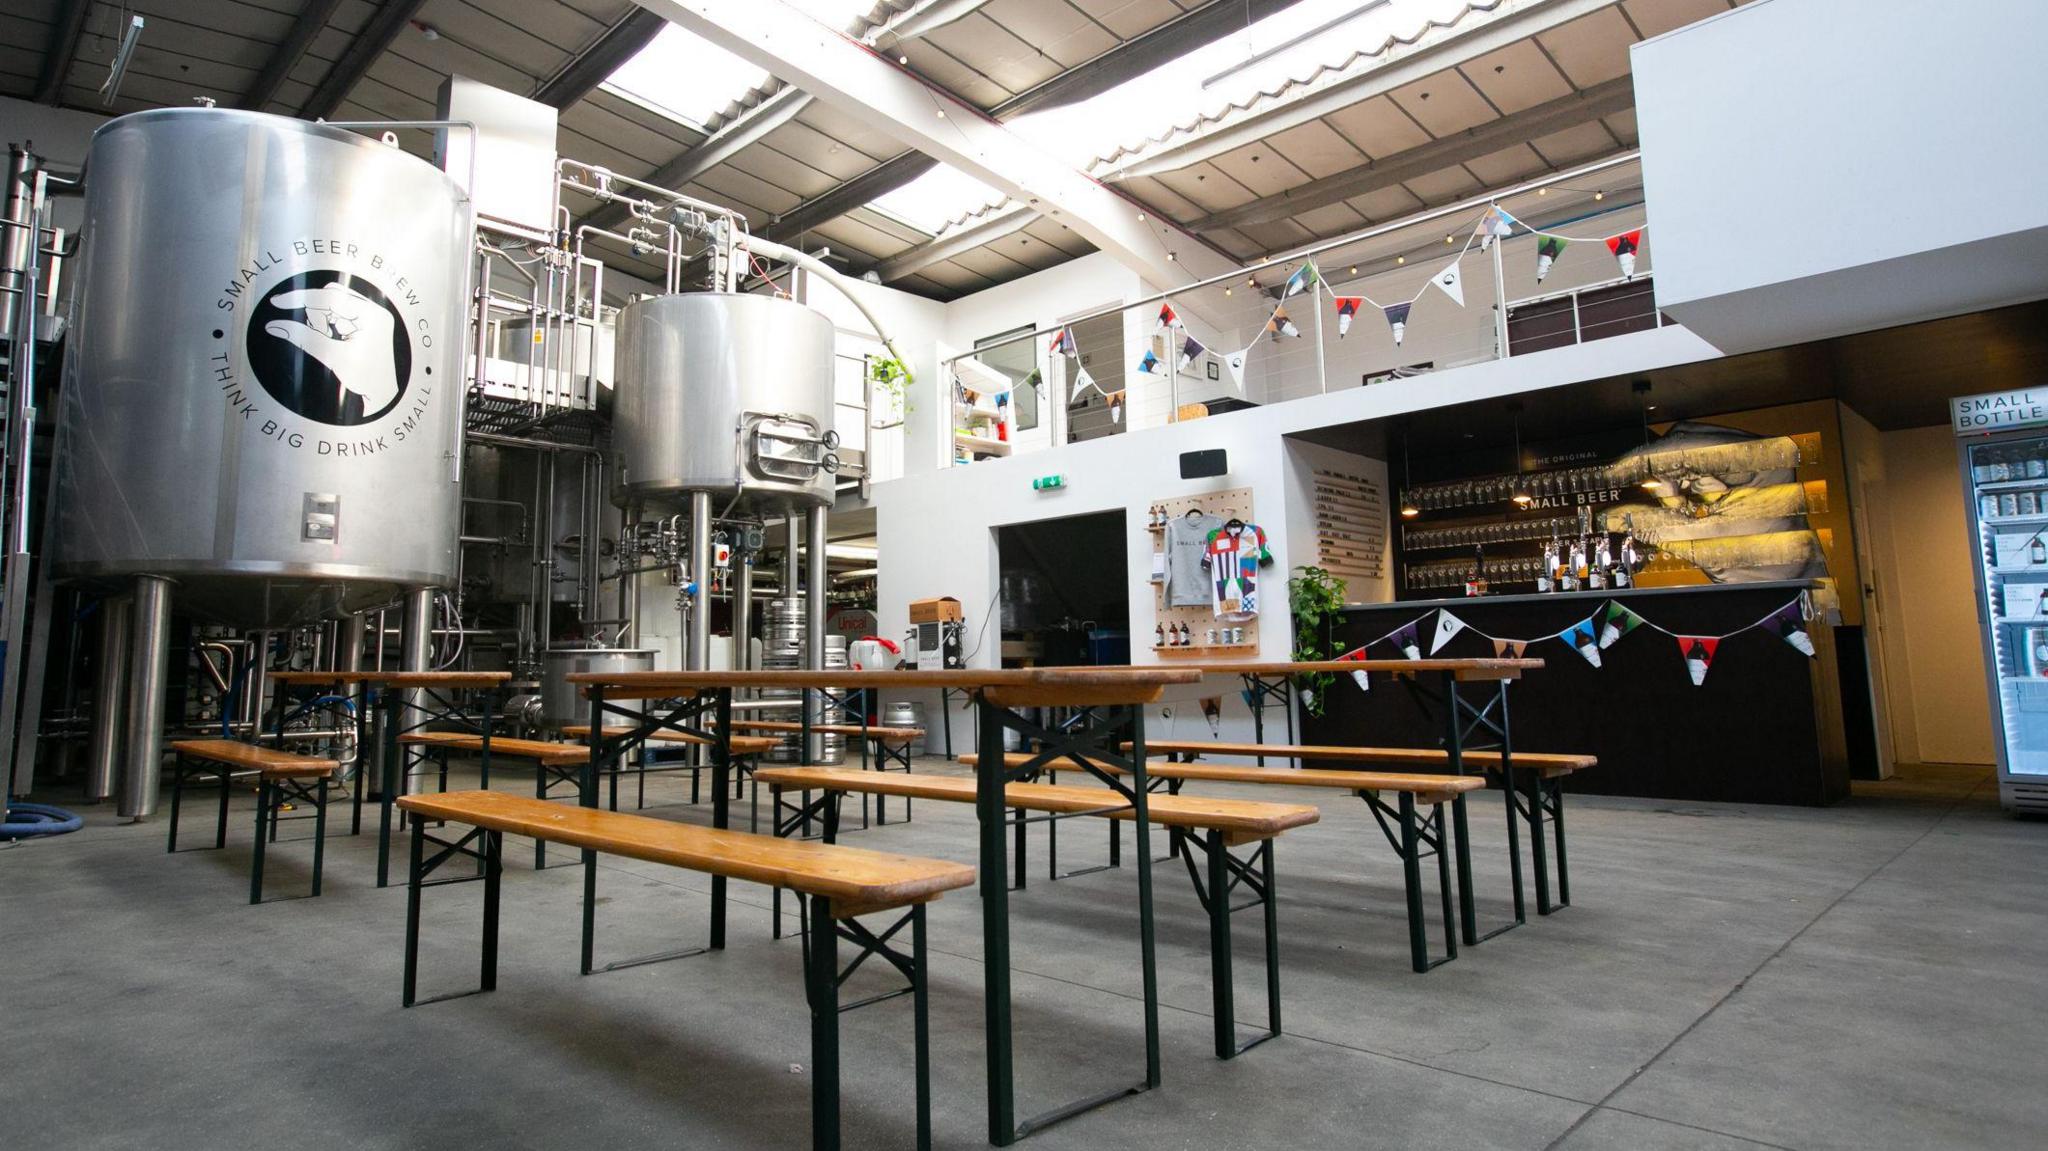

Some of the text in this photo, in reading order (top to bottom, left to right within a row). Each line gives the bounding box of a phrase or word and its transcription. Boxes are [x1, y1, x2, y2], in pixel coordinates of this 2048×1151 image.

[218, 239, 432, 348] SMALL BEER BEW CO
[211, 352, 431, 457] THINK BIG DRINK SMALL
[1960, 393, 2035, 413] SMALL
[1960, 406, 2043, 427] BOTTLE
[1553, 451, 1598, 463] ORIGINAL
[1520, 490, 1620, 511] SMALL BEER
[1539, 539, 1570, 549] LGER
